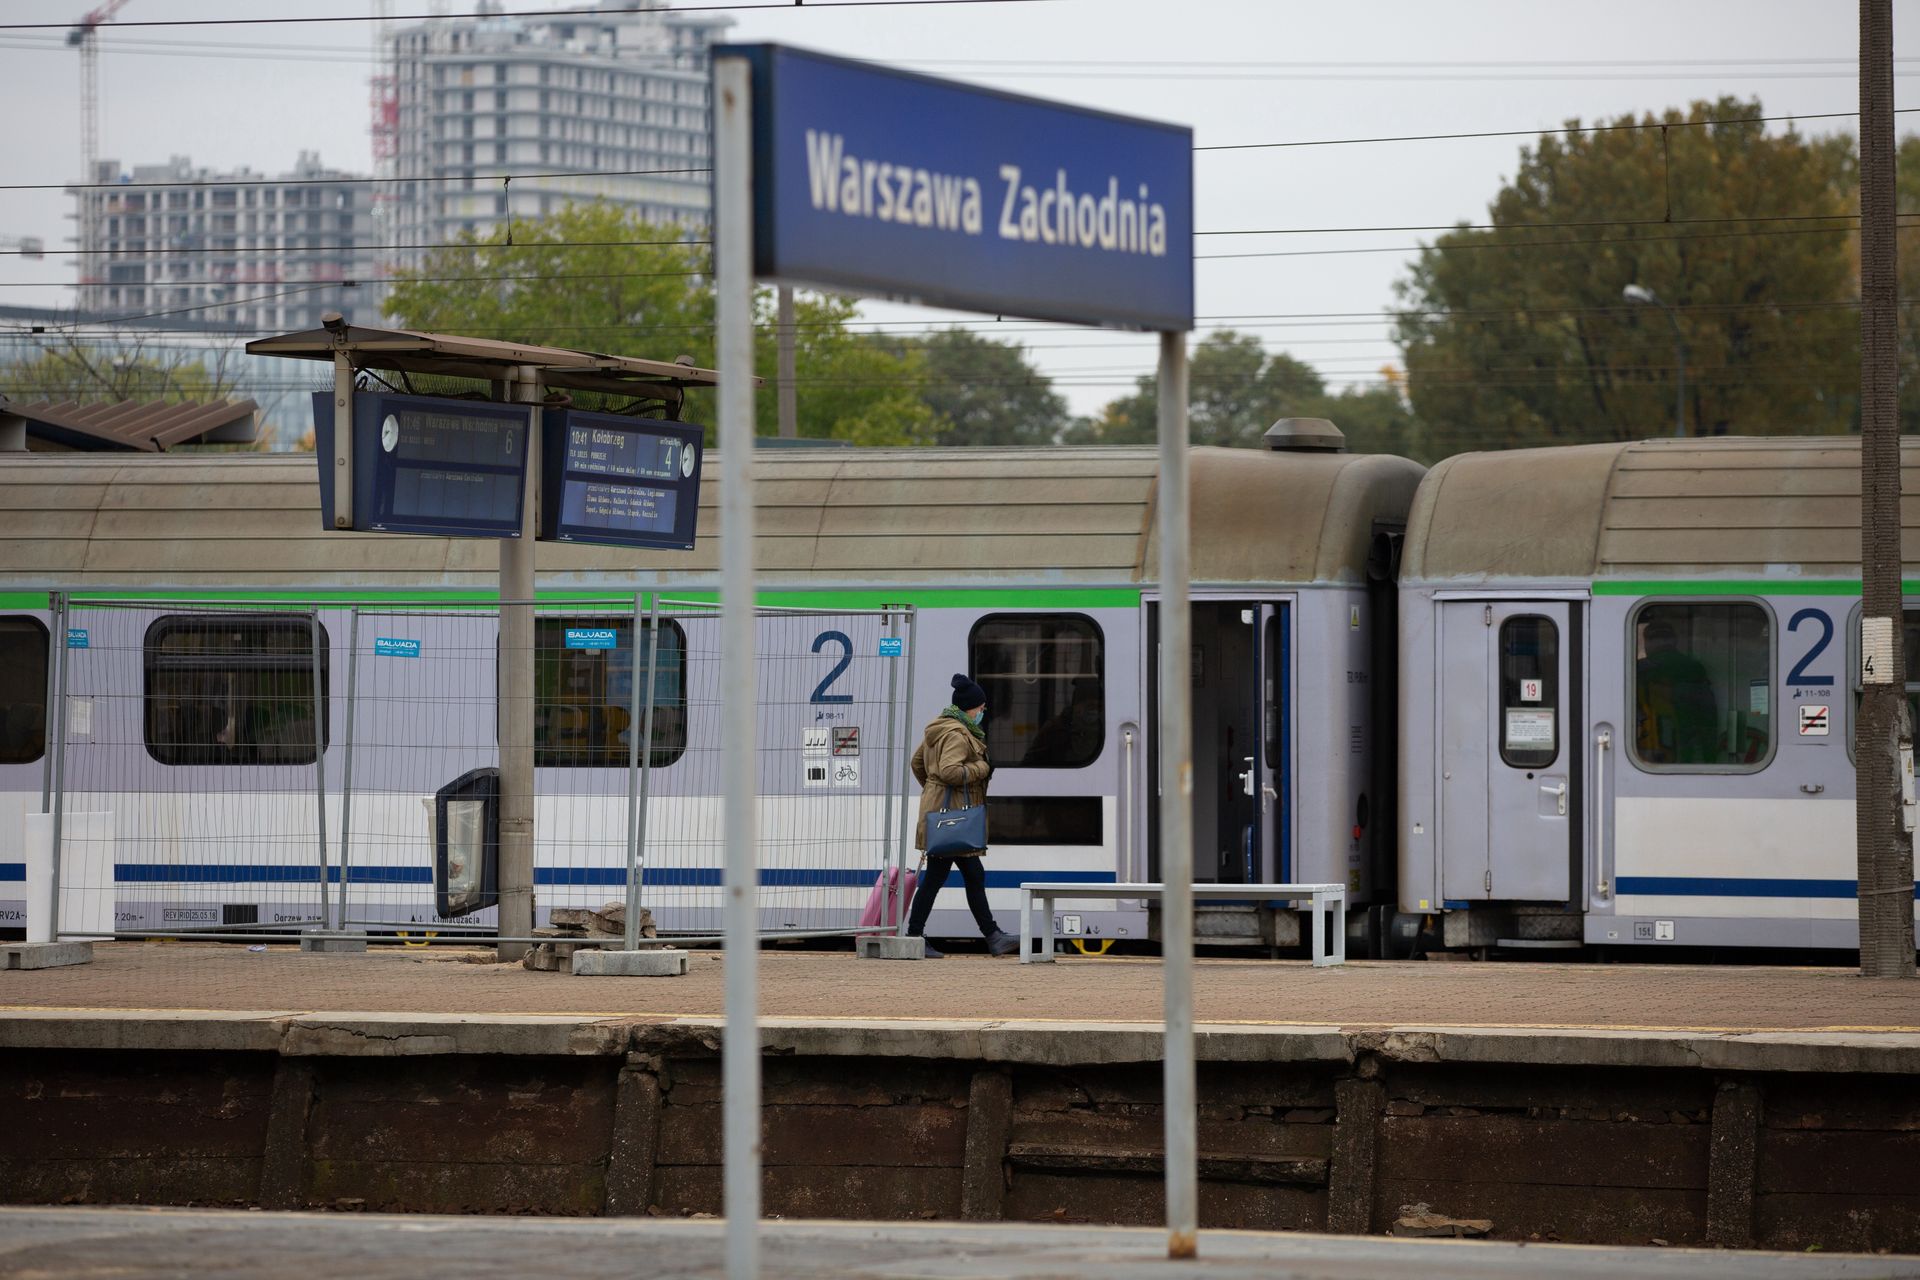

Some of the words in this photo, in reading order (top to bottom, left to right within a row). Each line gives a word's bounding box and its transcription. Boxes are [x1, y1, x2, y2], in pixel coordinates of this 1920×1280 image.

[805, 128, 982, 235] Warszawa
[999, 164, 1167, 257] Zachodnia
[505, 430, 513, 455] 6
[572, 431, 587, 445] 10:41
[592, 429, 625, 449] Kołobrzeg
[665, 446, 672, 470] 4
[377, 640, 418, 649] SALVADA
[567, 631, 614, 639] SALVADA
[1785, 608, 1835, 686] 2
[810, 630, 854, 704] 2
[1864, 655, 1874, 675] 4
[1526, 683, 1537, 697] 19
[0, 910, 27, 920] RV2A-
[165, 910, 177, 920] REV
[180, 910, 190, 920] RID
